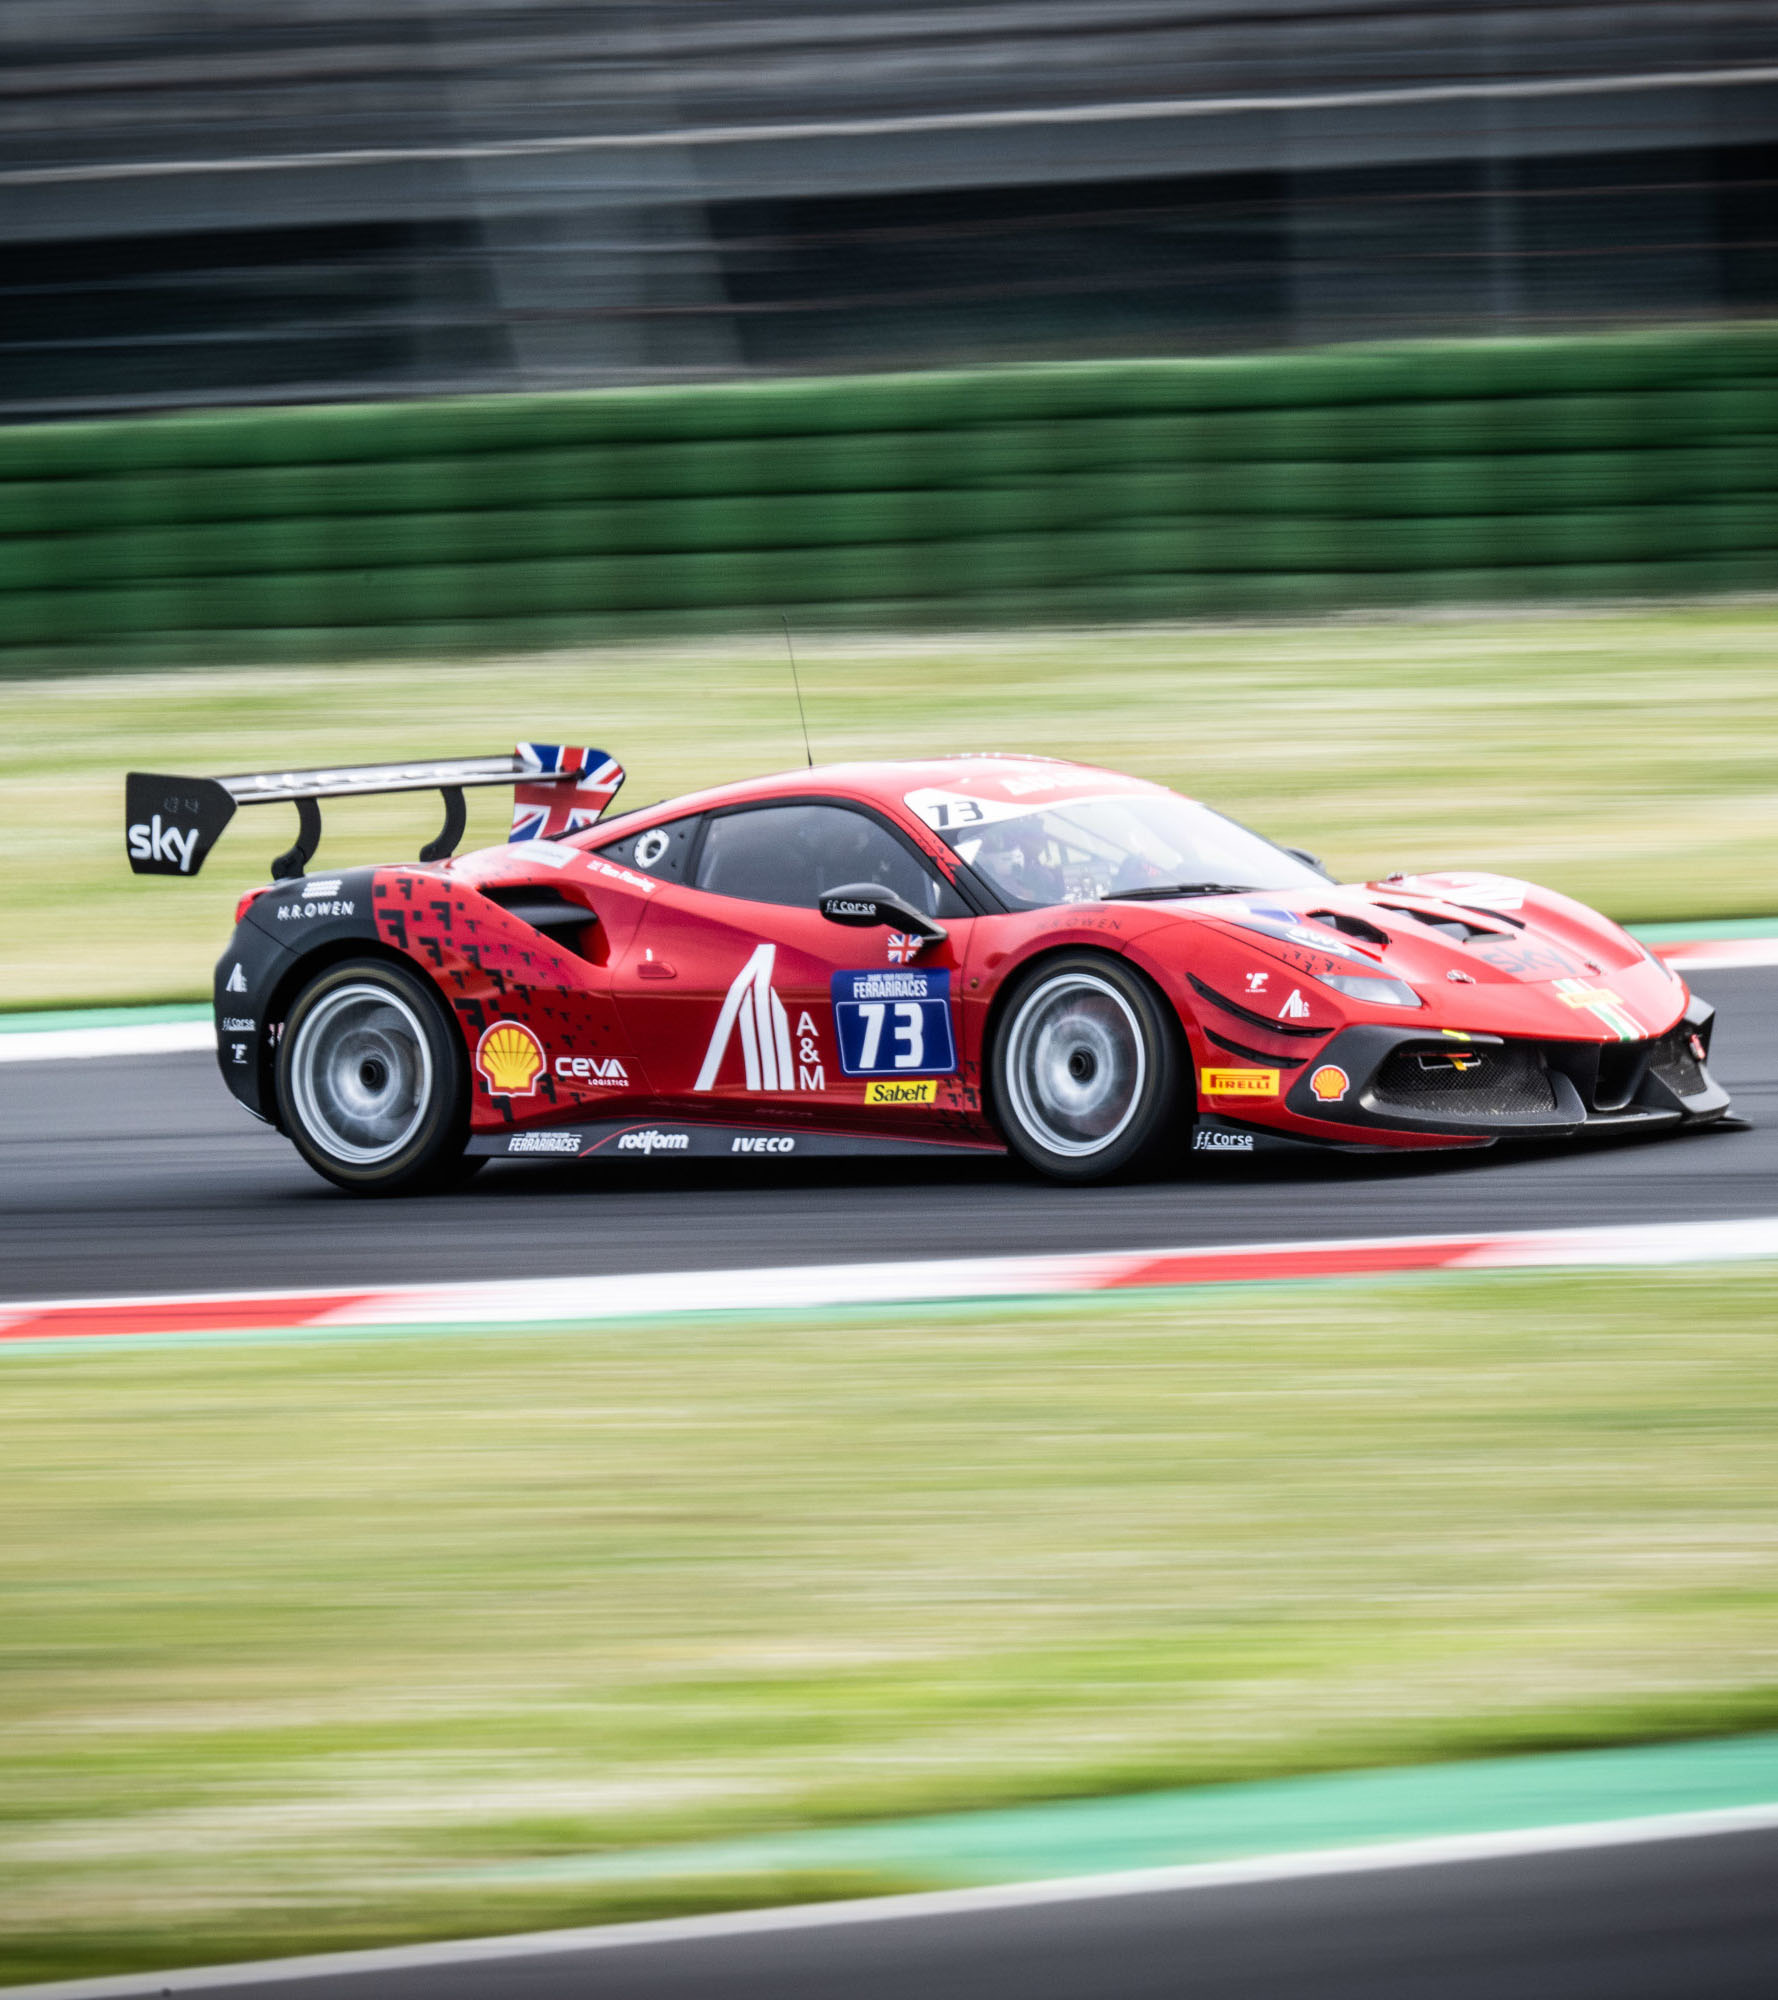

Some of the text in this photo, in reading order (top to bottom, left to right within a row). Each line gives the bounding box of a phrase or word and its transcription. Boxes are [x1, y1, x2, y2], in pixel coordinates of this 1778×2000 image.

[928, 801, 984, 827] 73
[128, 814, 199, 872] sky
[858, 1002, 924, 1069] 73
[587, 1078, 630, 1087] LOGISTICS
[872, 1083, 929, 1102] Sabelt
[1210, 1074, 1271, 1089] PIRELLI
[617, 1130, 690, 1155] rotiform
[731, 1137, 796, 1152] IVECO
